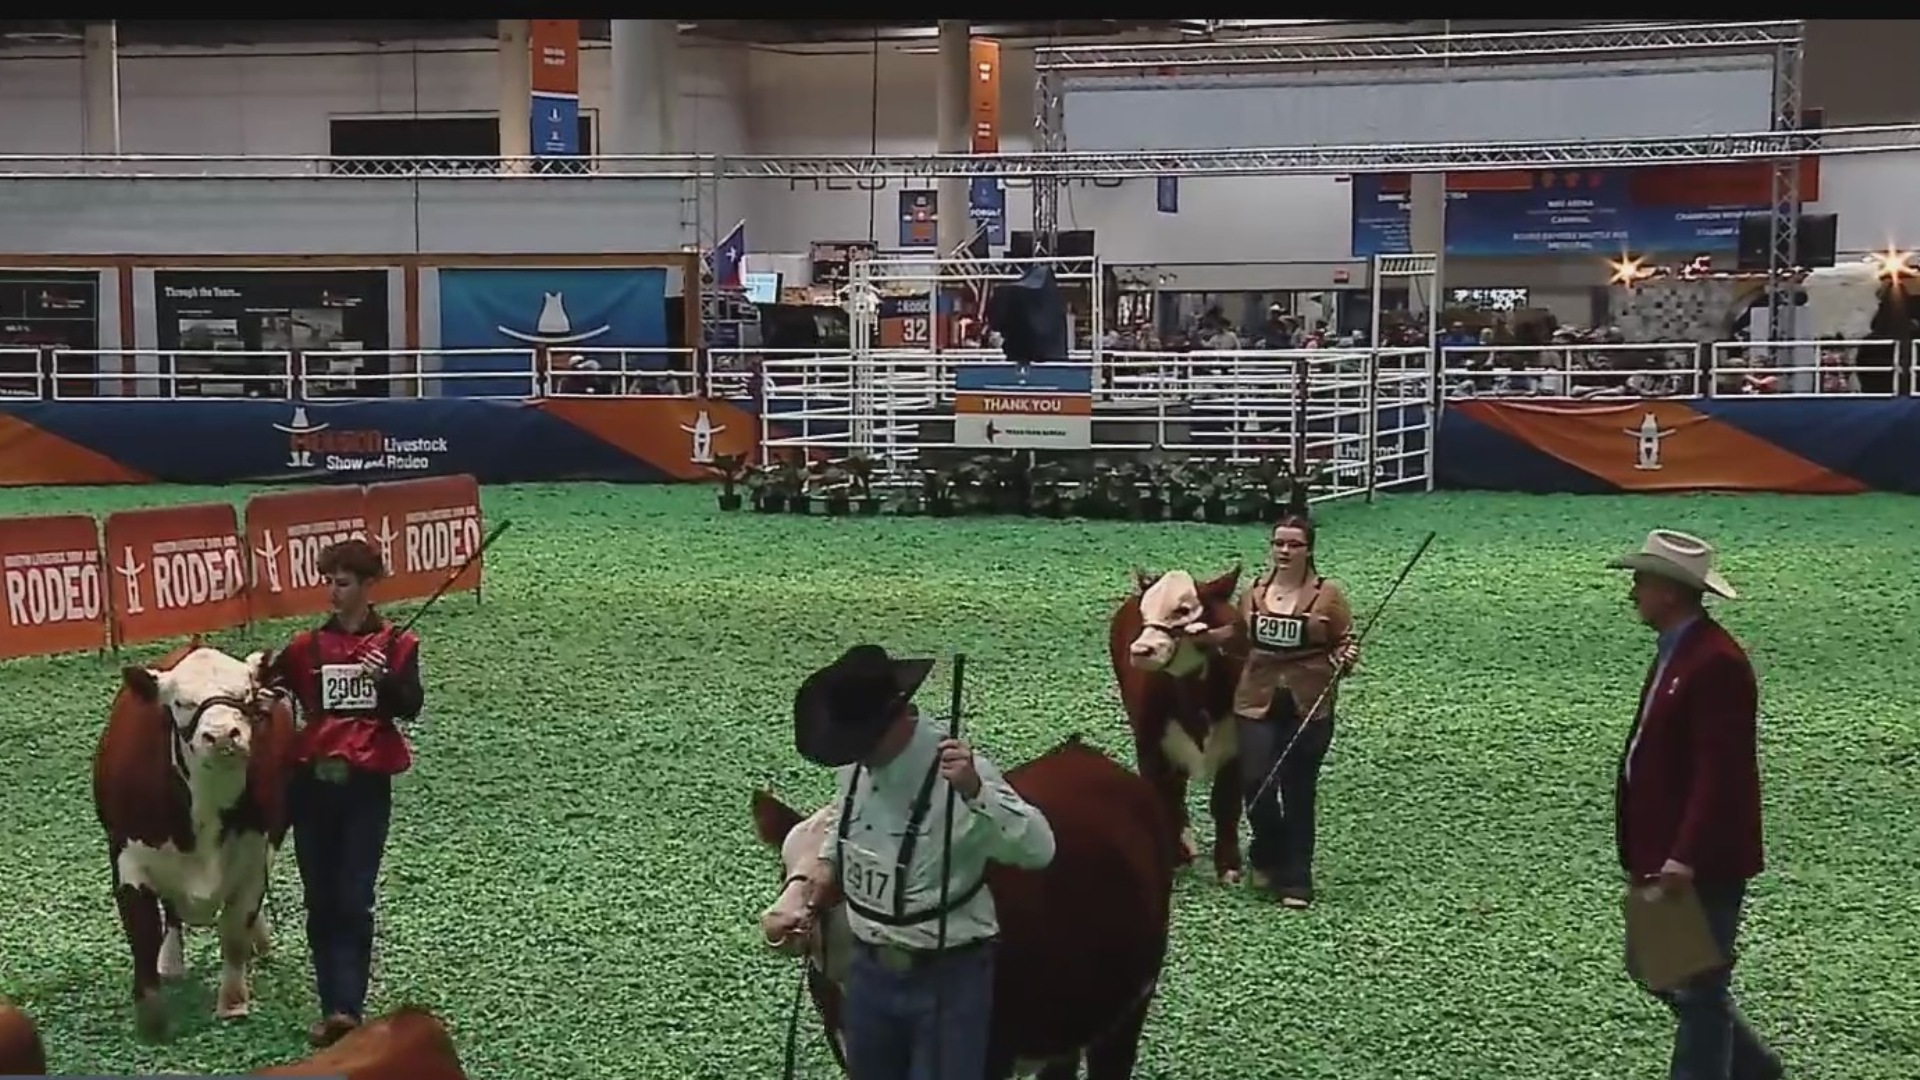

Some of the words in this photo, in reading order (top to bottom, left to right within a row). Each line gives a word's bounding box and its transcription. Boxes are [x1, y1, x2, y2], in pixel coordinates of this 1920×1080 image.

[199, 286, 212, 297] the
[903, 318, 928, 341] 32
[984, 398, 1028, 412] THANK
[1031, 399, 1061, 412] YOU
[384, 438, 447, 452] Livestock
[326, 455, 363, 470] Show
[363, 455, 386, 469] and
[387, 455, 428, 470] Rodeo
[406, 517, 480, 572] RODEO
[152, 548, 243, 609] RODEO
[5, 564, 101, 626] RODEO
[1259, 618, 1298, 639] 2910
[327, 677, 374, 700] 2905
